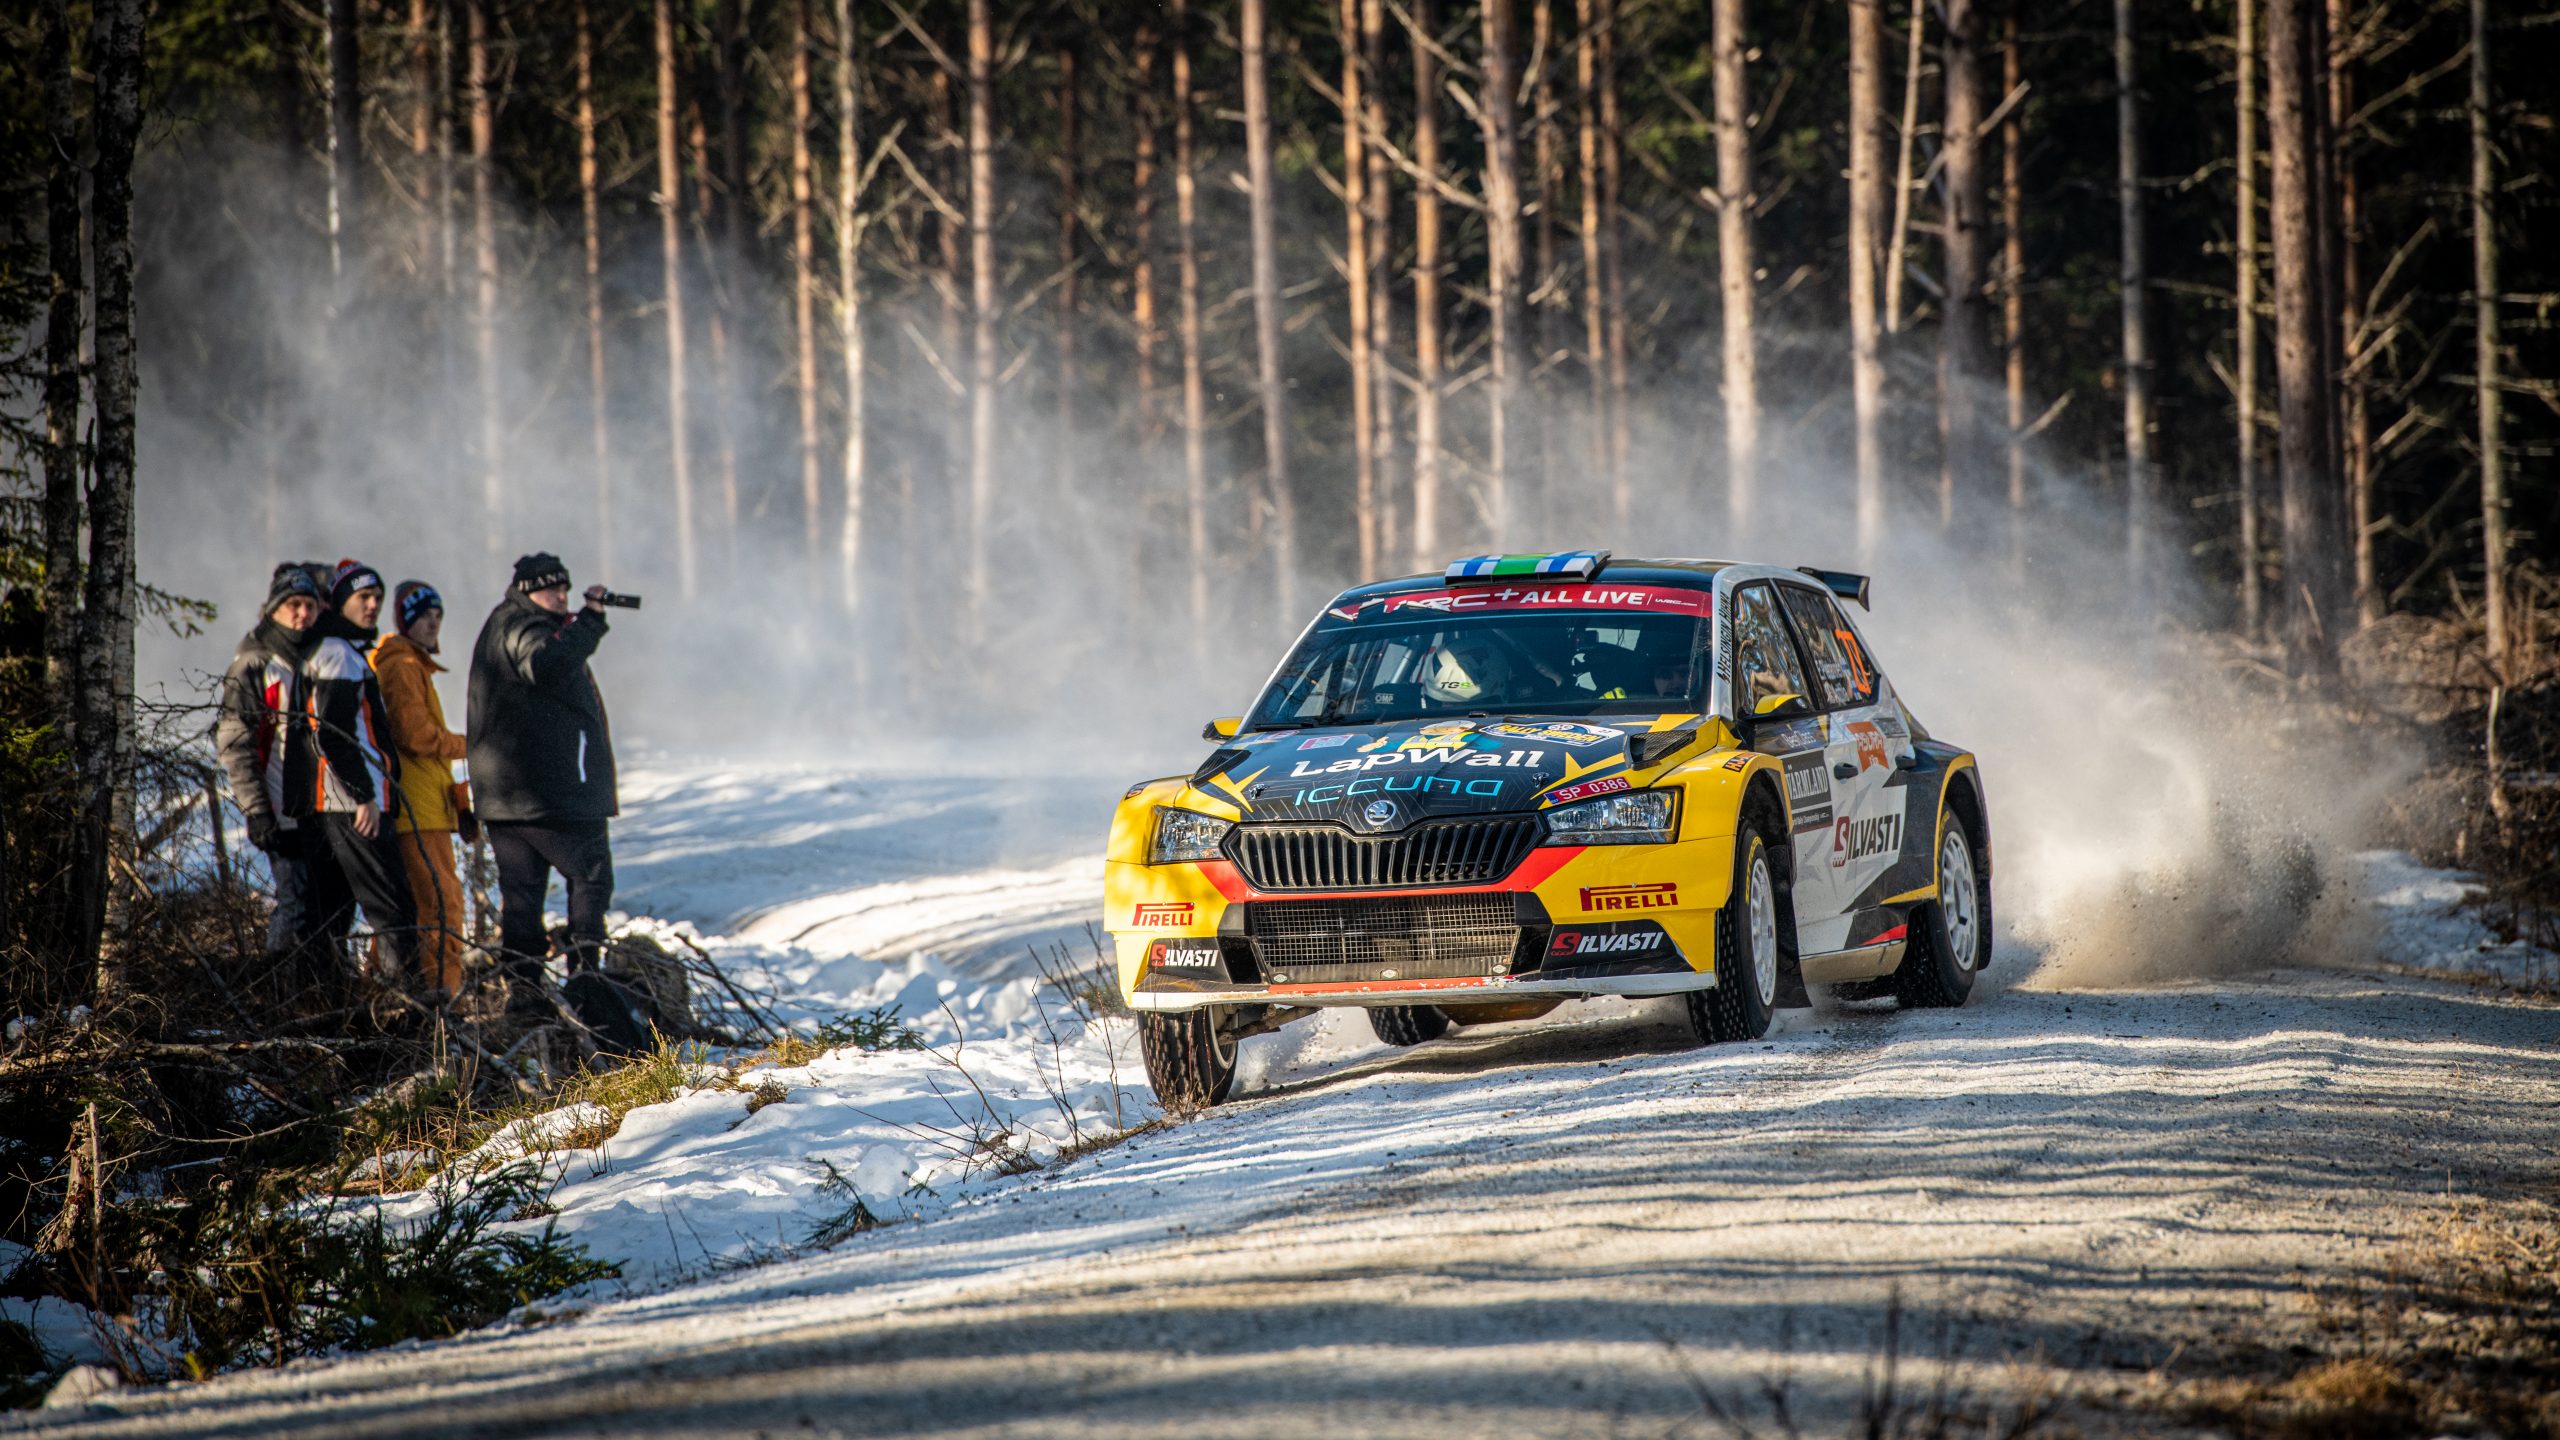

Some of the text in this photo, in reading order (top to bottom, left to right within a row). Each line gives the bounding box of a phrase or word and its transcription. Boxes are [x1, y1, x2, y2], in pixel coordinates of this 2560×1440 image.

[1520, 591, 1573, 604] ALL
[1582, 591, 1646, 605] LIVE
[1290, 748, 1545, 777] LapWall
[1558, 777, 1629, 801] SP 0386
[1833, 812, 1901, 868] SILVASTI
[1579, 882, 1679, 912] PIRELLI
[1132, 902, 1195, 927] PIRELLI
[1151, 943, 1219, 967] SILVASTI
[1551, 931, 1664, 957] SILVASTI
